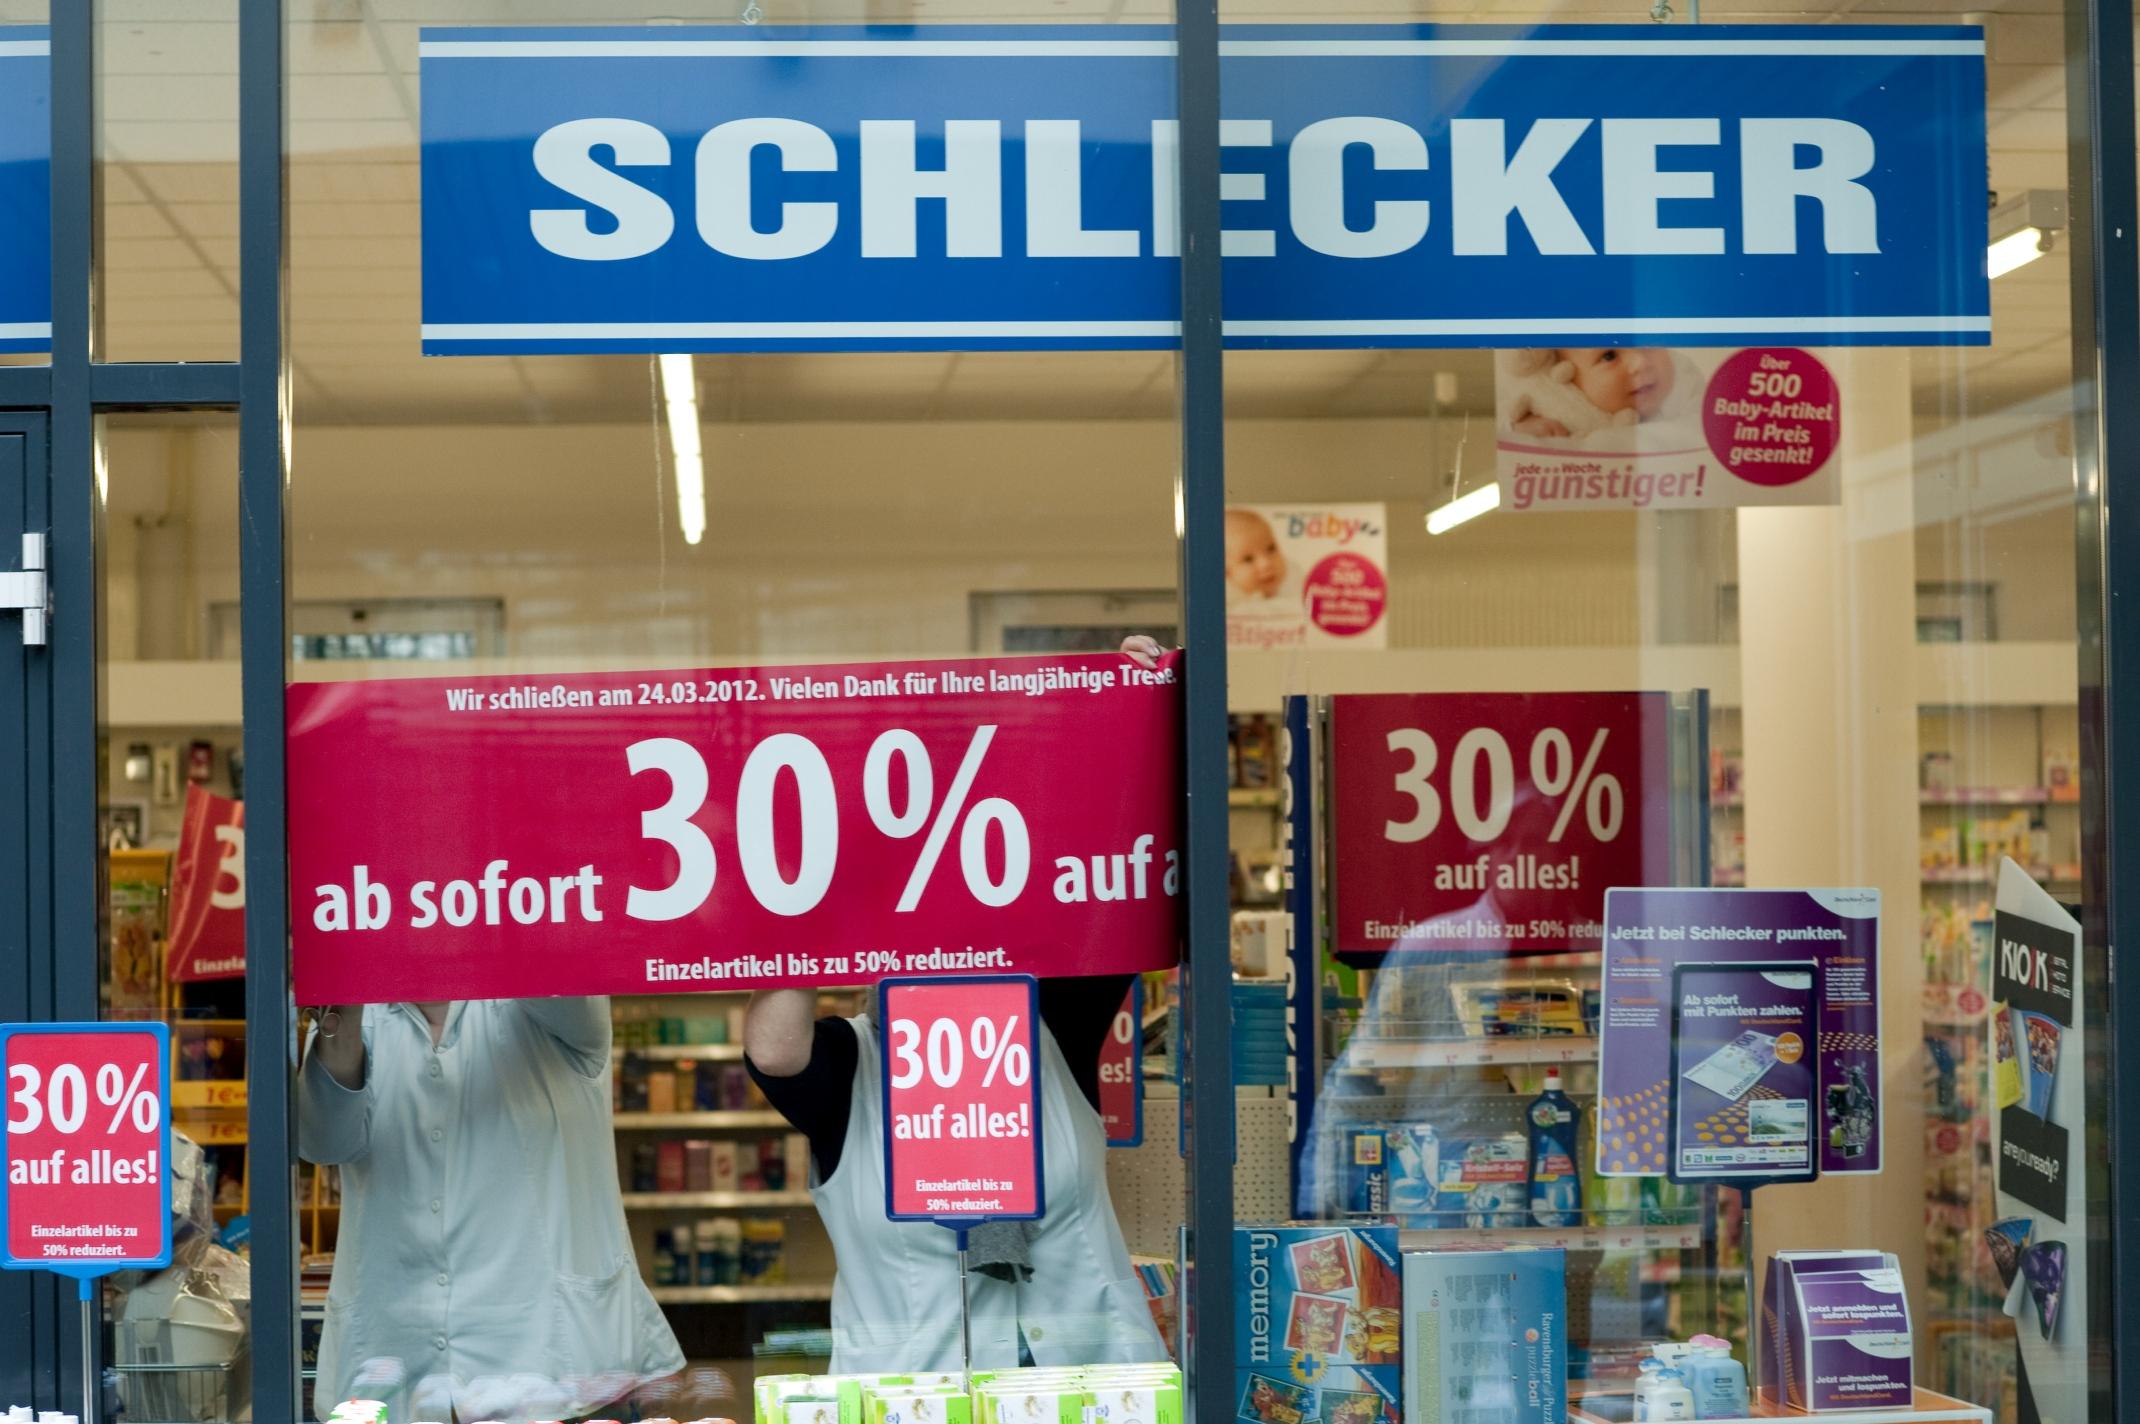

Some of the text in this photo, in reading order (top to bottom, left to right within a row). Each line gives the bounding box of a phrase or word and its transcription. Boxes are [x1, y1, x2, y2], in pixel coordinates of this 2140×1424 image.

[529, 116, 1883, 261] SCHLECKER
[1748, 372, 1802, 398] 500
[1714, 397, 1833, 422] Baby-Artikel
[1734, 421, 1811, 444] im Preis
[1729, 446, 1814, 466] gesenkt!
[1288, 513, 1361, 544] baby
[446, 688, 485, 711] Wir
[489, 684, 594, 710] schließen
[598, 688, 634, 707] am
[638, 680, 766, 705] 24.03.2012.
[769, 675, 839, 701] Vielen
[844, 673, 899, 698] Dank
[902, 671, 937, 695] für
[942, 670, 985, 694] Ihre
[989, 666, 1115, 696] langjährige
[314, 864, 392, 932] ab
[409, 858, 603, 930] sofort
[1053, 834, 1154, 903] auf
[1434, 853, 1580, 890] auf alles!
[1365, 919, 1473, 939] Einzelartikel
[1477, 920, 1501, 938] bis
[1505, 923, 1526, 938] zu
[1530, 920, 1565, 938] 50%
[1611, 925, 1848, 944] Jetzt bei Schlecker punkten.
[645, 946, 1013, 982] Einzelartikel bis zu 50% reduziert.
[1683, 994, 1739, 1006] Ab sofort
[1683, 1006, 1704, 1017] mit
[1707, 1006, 1757, 1017] Punkten
[894, 1103, 1029, 1139] auf alles!
[9, 1149, 158, 1185] auf alles!
[916, 1179, 1013, 1192] Einzelartikel bis zu
[926, 1198, 1003, 1211] 50% reduziert.
[31, 1224, 138, 1238] Einzelartikel bis zu
[43, 1244, 127, 1256] 50% reduziert.
[1250, 1233, 1279, 1363] memory
